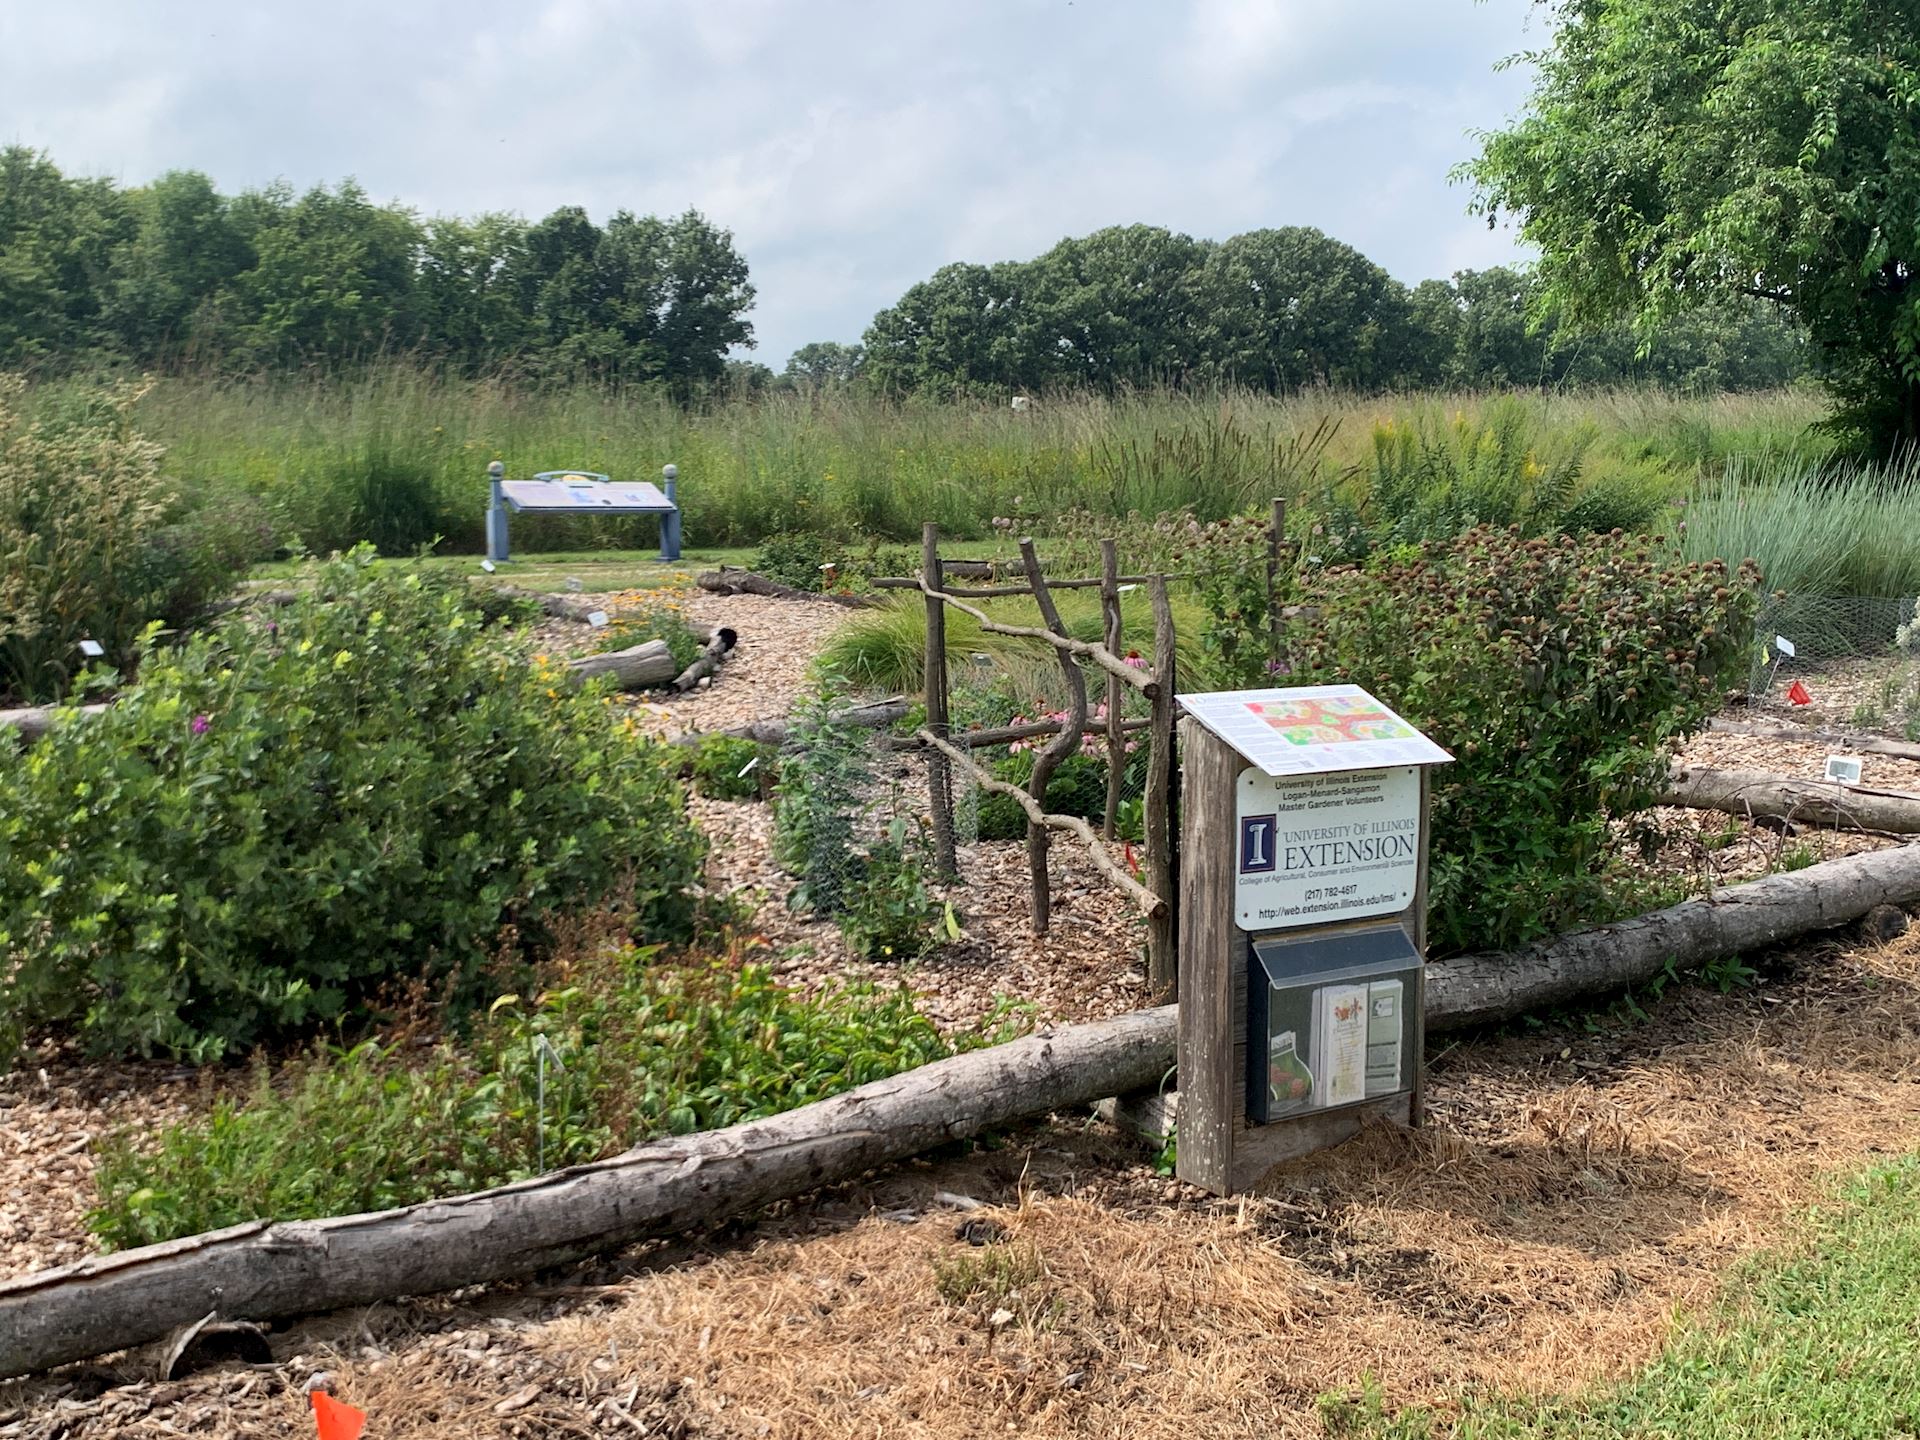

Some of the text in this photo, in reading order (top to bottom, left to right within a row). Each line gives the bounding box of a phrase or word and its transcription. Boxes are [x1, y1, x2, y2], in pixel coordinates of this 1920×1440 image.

[1275, 773, 1387, 790] University of Illinois Extension
[1283, 785, 1380, 801] Logan-Menard-Sangamon
[1279, 795, 1384, 812] Master Gardener Volunteers
[1284, 818, 1415, 843] UNIVERSITY OF ILLINOIS
[1285, 833, 1415, 870] EXTENSION
[1238, 876, 1263, 886] College
[1308, 867, 1338, 879] Consumer
[1339, 866, 1350, 874] and
[1304, 888, 1323, 902] (217)
